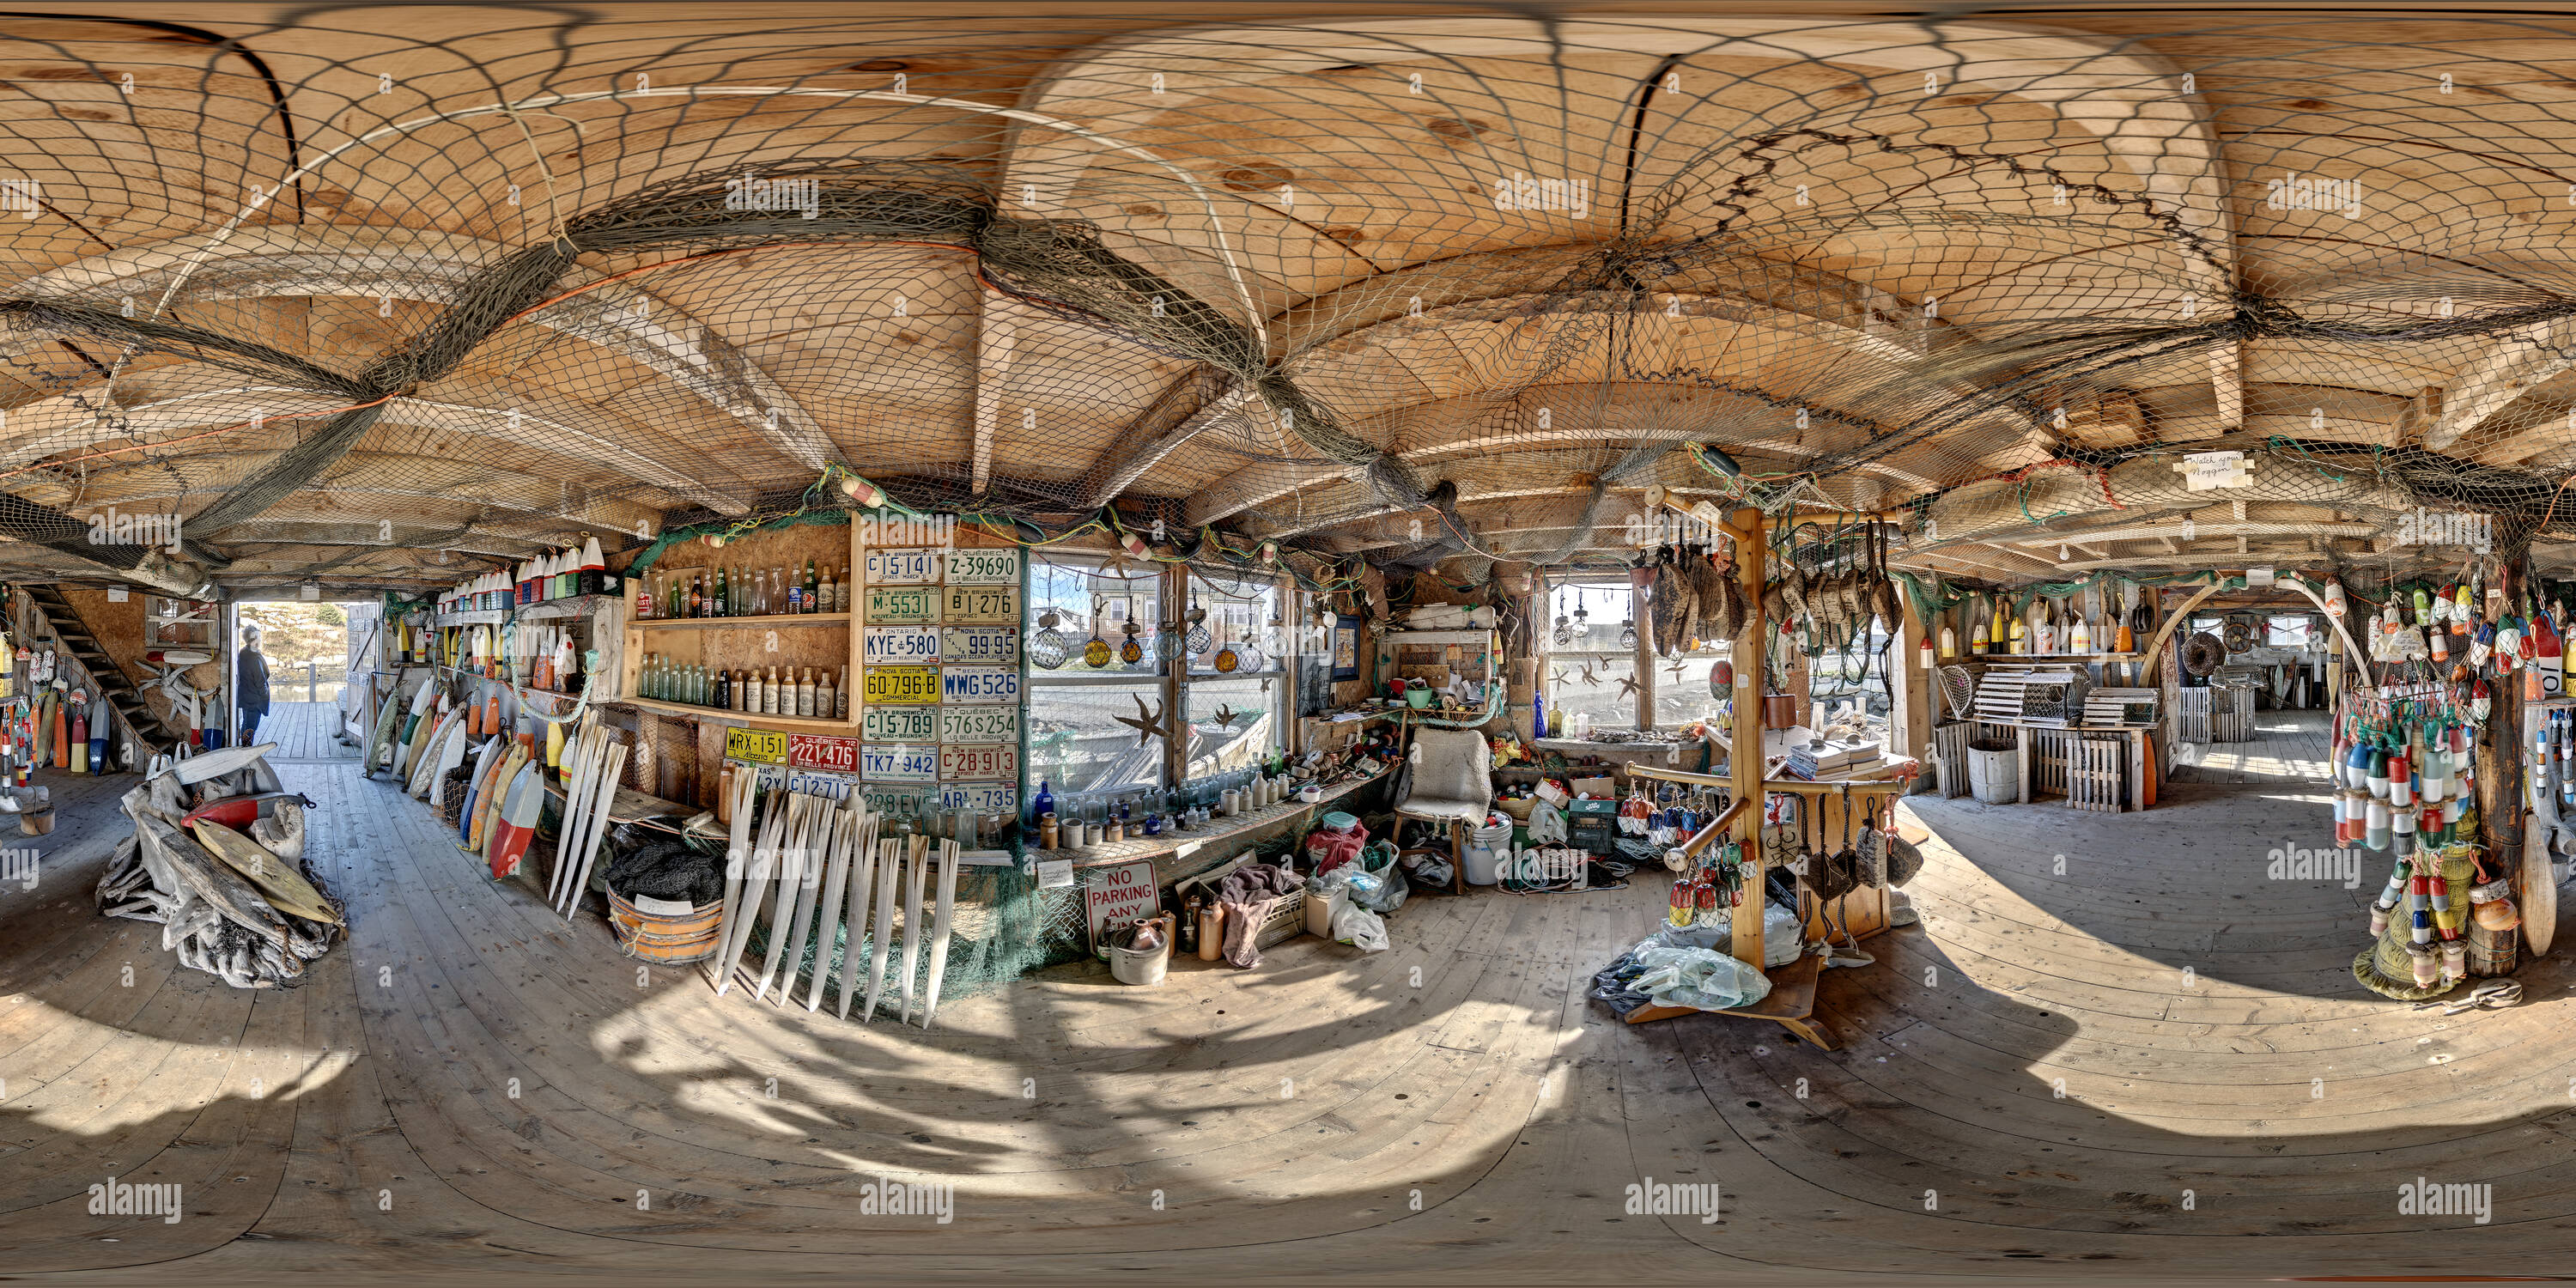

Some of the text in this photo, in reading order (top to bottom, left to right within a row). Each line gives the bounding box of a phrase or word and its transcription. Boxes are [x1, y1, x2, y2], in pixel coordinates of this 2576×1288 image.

[2190, 452, 2242, 467] Watch your
[2192, 468, 2231, 478] Noggin
[951, 557, 1014, 575] Z-39690
[867, 635, 936, 655] KYE 580
[945, 674, 1017, 695] WWG 526
[1108, 870, 1132, 887] NO
[1092, 884, 1152, 906] PARKING
[1109, 903, 1142, 918] ANY
